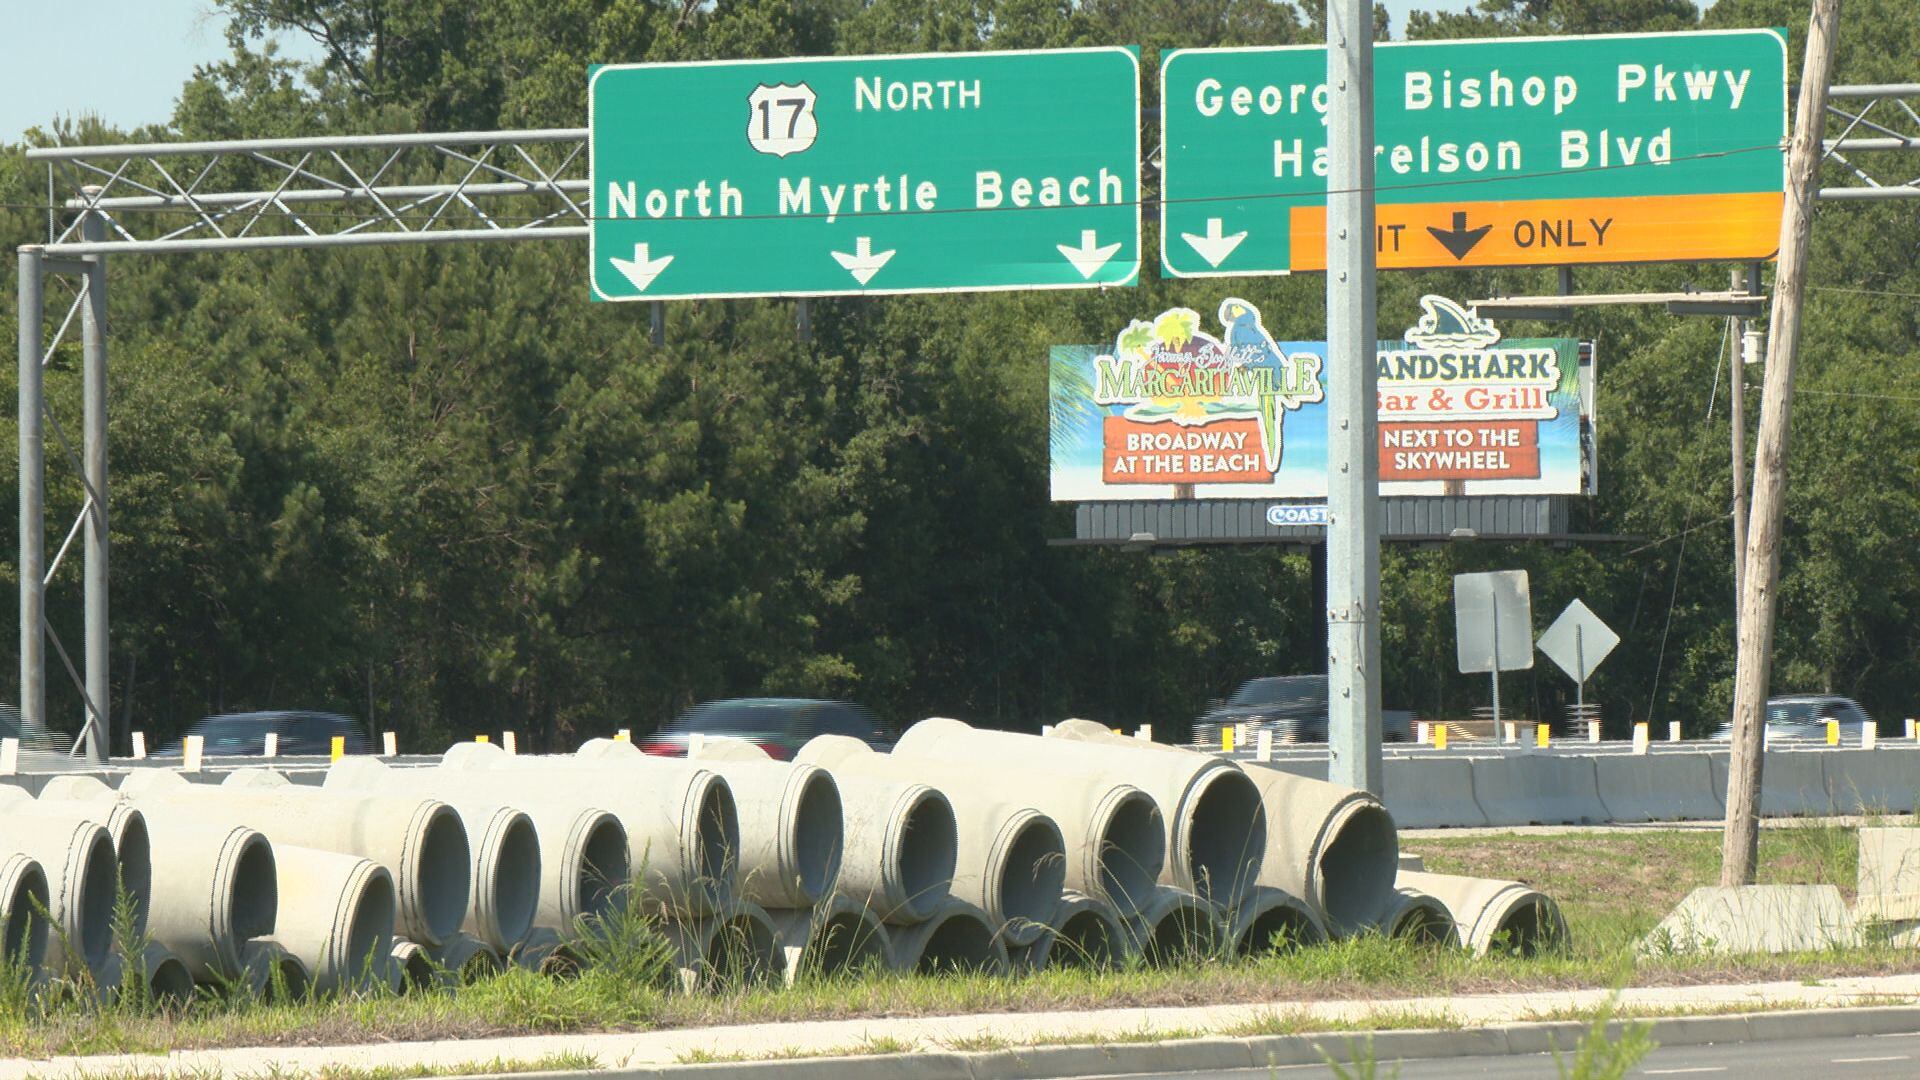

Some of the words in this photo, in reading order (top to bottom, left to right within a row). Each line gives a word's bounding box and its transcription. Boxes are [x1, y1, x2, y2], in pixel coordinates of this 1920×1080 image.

[855, 77, 981, 112] NORTH
[1196, 78, 1328, 126] Georg
[1405, 68, 1577, 114] Bishop
[1617, 63, 1751, 110] Pkwy
[758, 98, 809, 140] 17
[1274, 136, 1521, 178] Harelson
[1561, 127, 1671, 168] Blvd
[608, 179, 743, 218] North
[778, 174, 938, 223] Myrtle
[976, 168, 1122, 209] Beach
[1378, 224, 1406, 252] IT
[1514, 217, 1613, 248] ONLY
[1099, 358, 1315, 399] MARGARITAVILLE
[1376, 353, 1550, 381] ANDSHARK
[1377, 391, 1418, 411] ar
[1428, 388, 1453, 411] &
[1464, 387, 1543, 411] Grill
[1127, 432, 1248, 452] BROADWAY
[1384, 430, 1440, 448] NEXT
[1443, 429, 1473, 448] TO
[1478, 428, 1520, 447] THE
[1112, 455, 1137, 474] AT
[1143, 454, 1184, 473] THE
[1190, 453, 1260, 473] BEACH
[1394, 451, 1510, 470] SKYWHEEL
[1270, 508, 1329, 523] COAST
